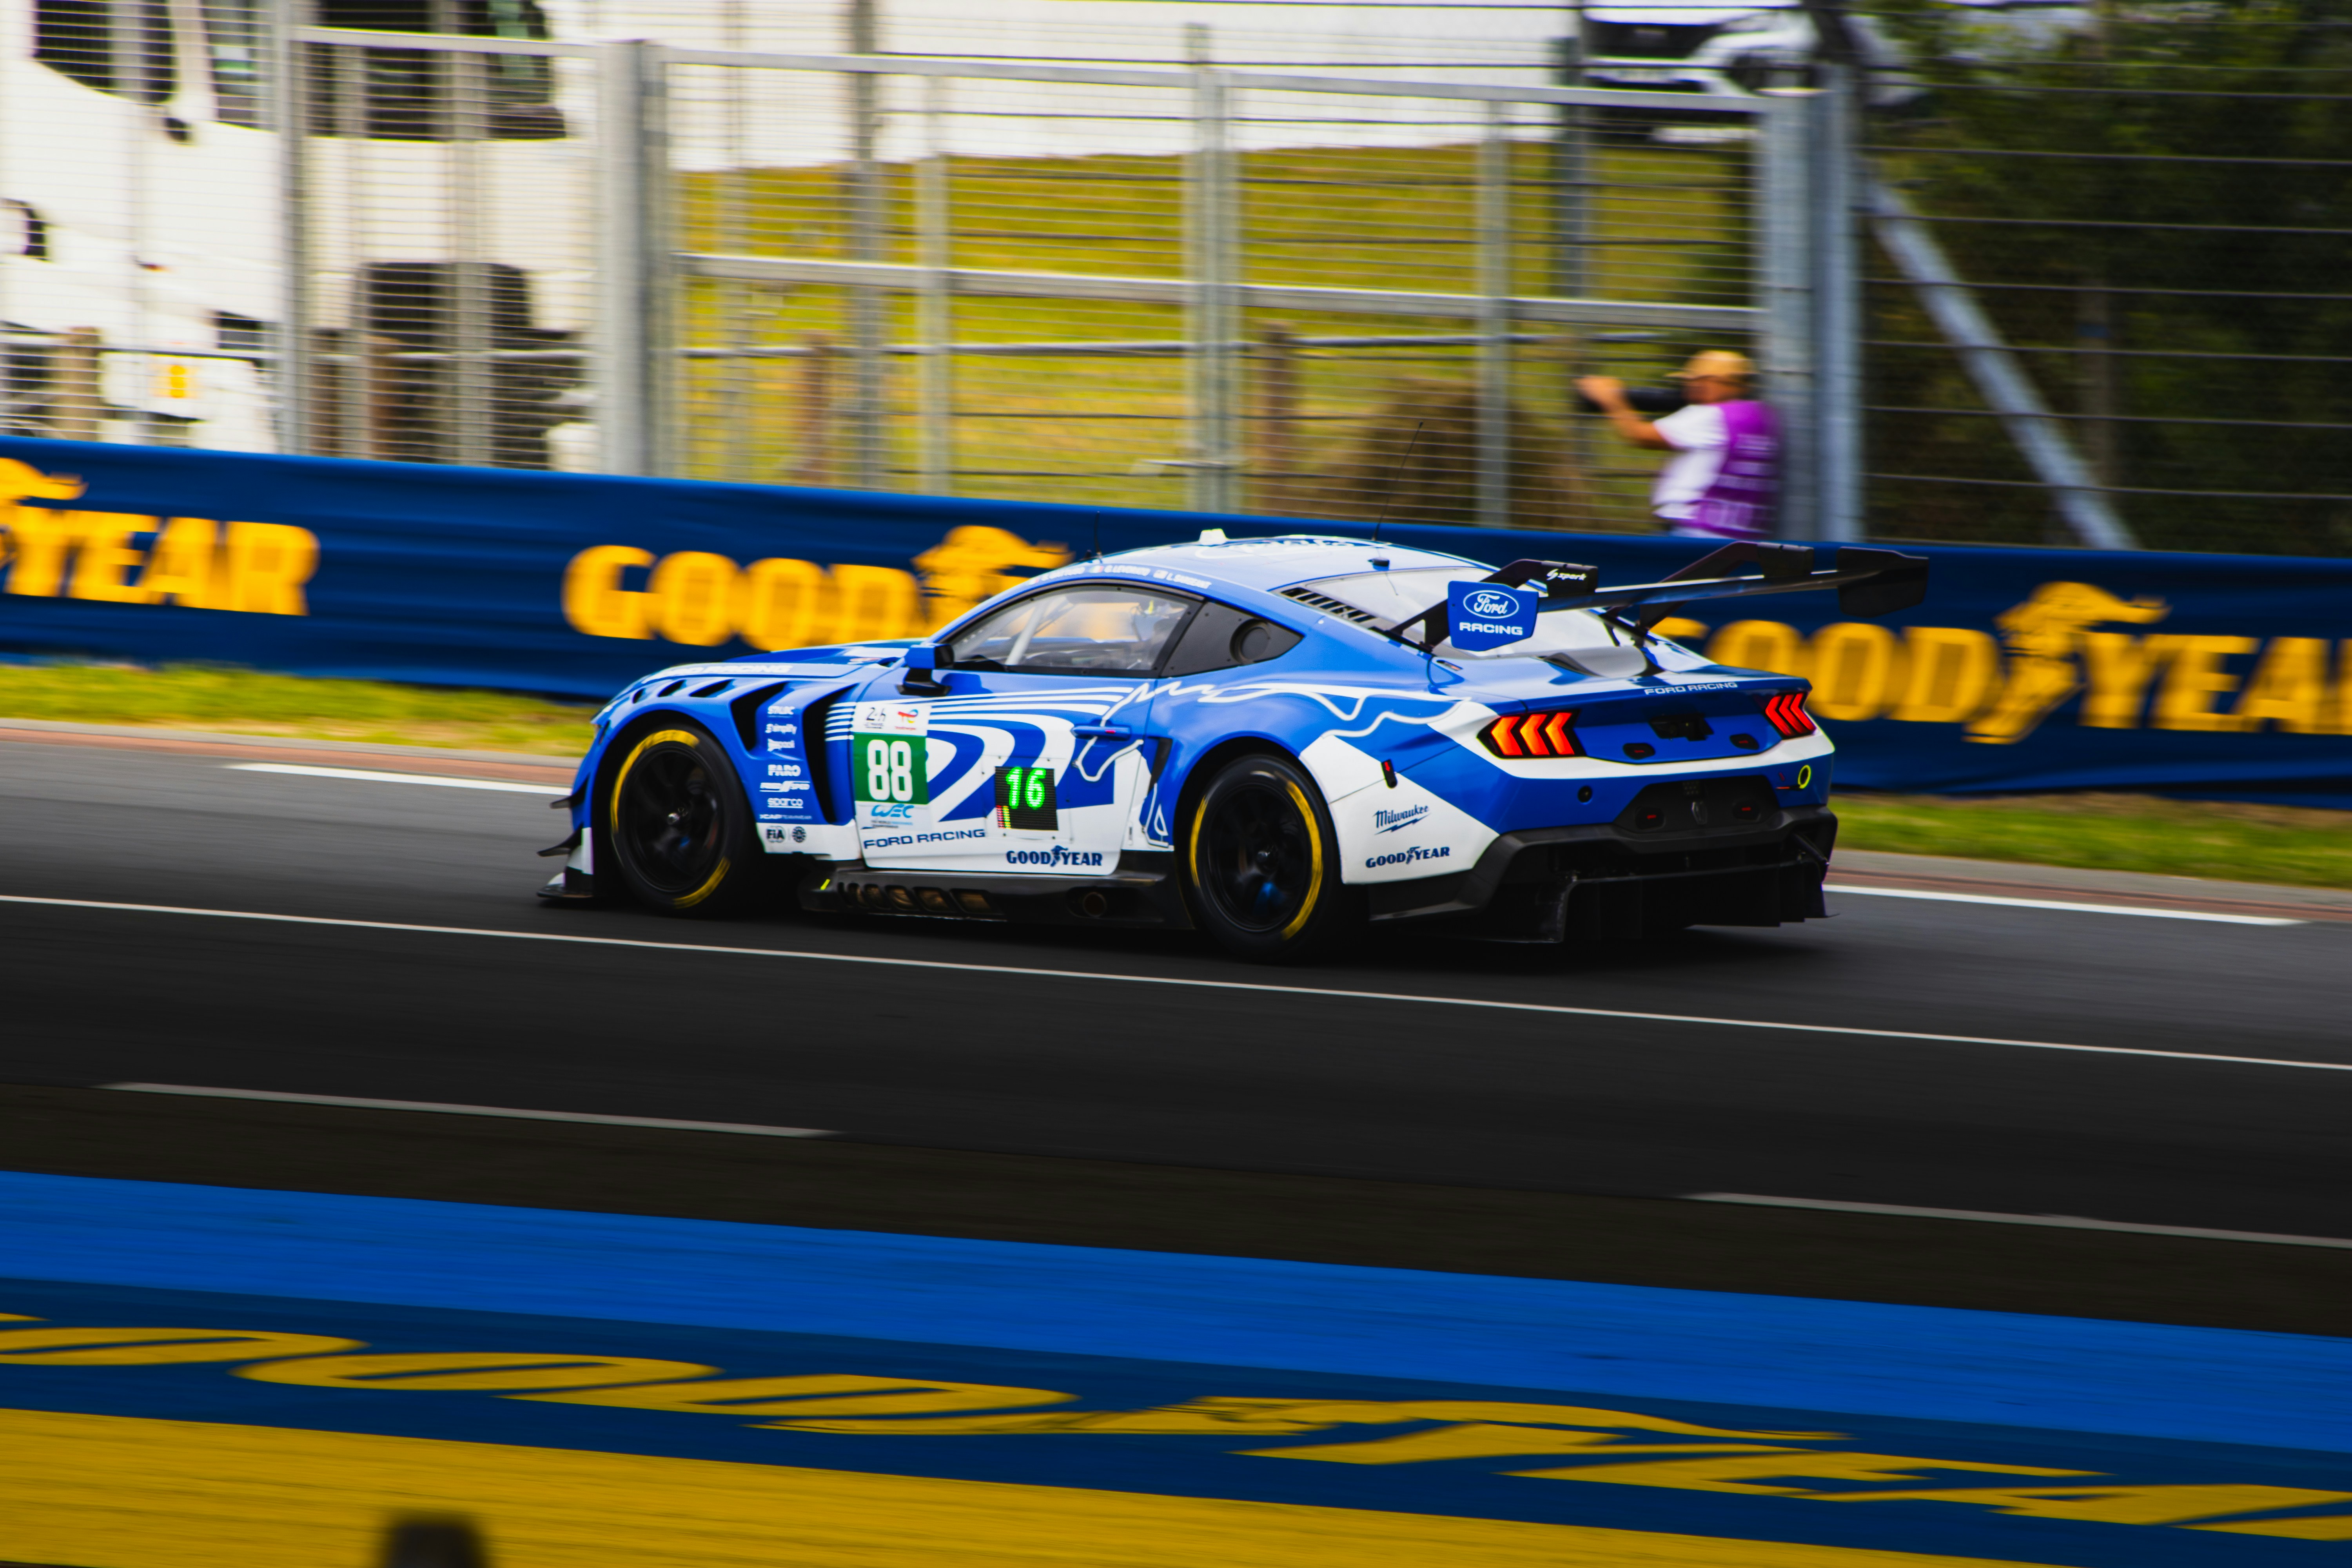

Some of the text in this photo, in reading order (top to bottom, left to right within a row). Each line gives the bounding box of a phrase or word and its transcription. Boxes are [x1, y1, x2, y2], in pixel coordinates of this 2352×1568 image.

[1474, 593, 1508, 615] Ford
[1459, 622, 1523, 636] RACING
[1644, 682, 1738, 695] FORD RACING
[768, 764, 801, 777] FARO
[867, 739, 913, 802] 88
[1005, 766, 1046, 810] 16
[767, 797, 804, 806] sparco
[871, 803, 915, 818] WEC
[1372, 804, 1429, 828] Milwaukee
[863, 829, 985, 849] FORD RACING
